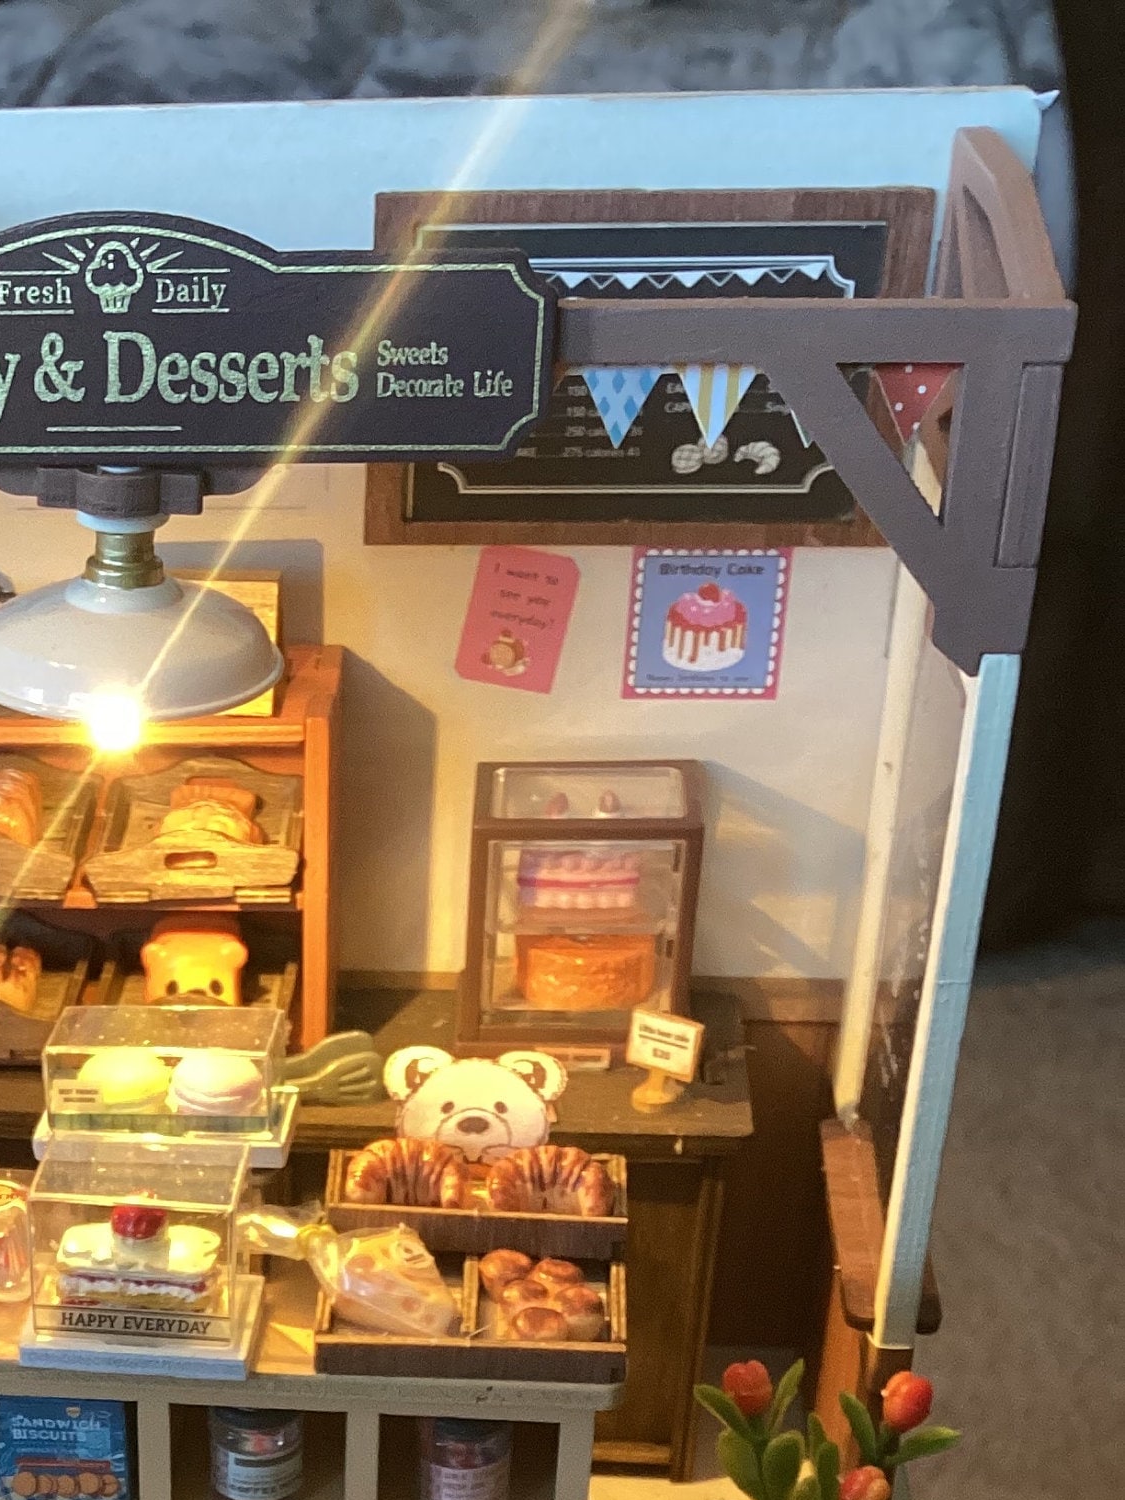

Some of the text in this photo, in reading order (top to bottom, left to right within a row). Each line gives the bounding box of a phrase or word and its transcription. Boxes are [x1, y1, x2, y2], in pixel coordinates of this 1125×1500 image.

[156, 279, 227, 313] Daily
[376, 340, 449, 369] Sweets
[35, 334, 86, 405] &
[103, 334, 360, 405] Desserts
[376, 370, 514, 400] Decorate Life
[659, 562, 764, 579] Birthday Cake
[61, 1311, 212, 1335] HAPPY EVERYDAY
[10, 1414, 101, 1431] SANDWICH
[11, 1428, 87, 1442] BISCUITS
